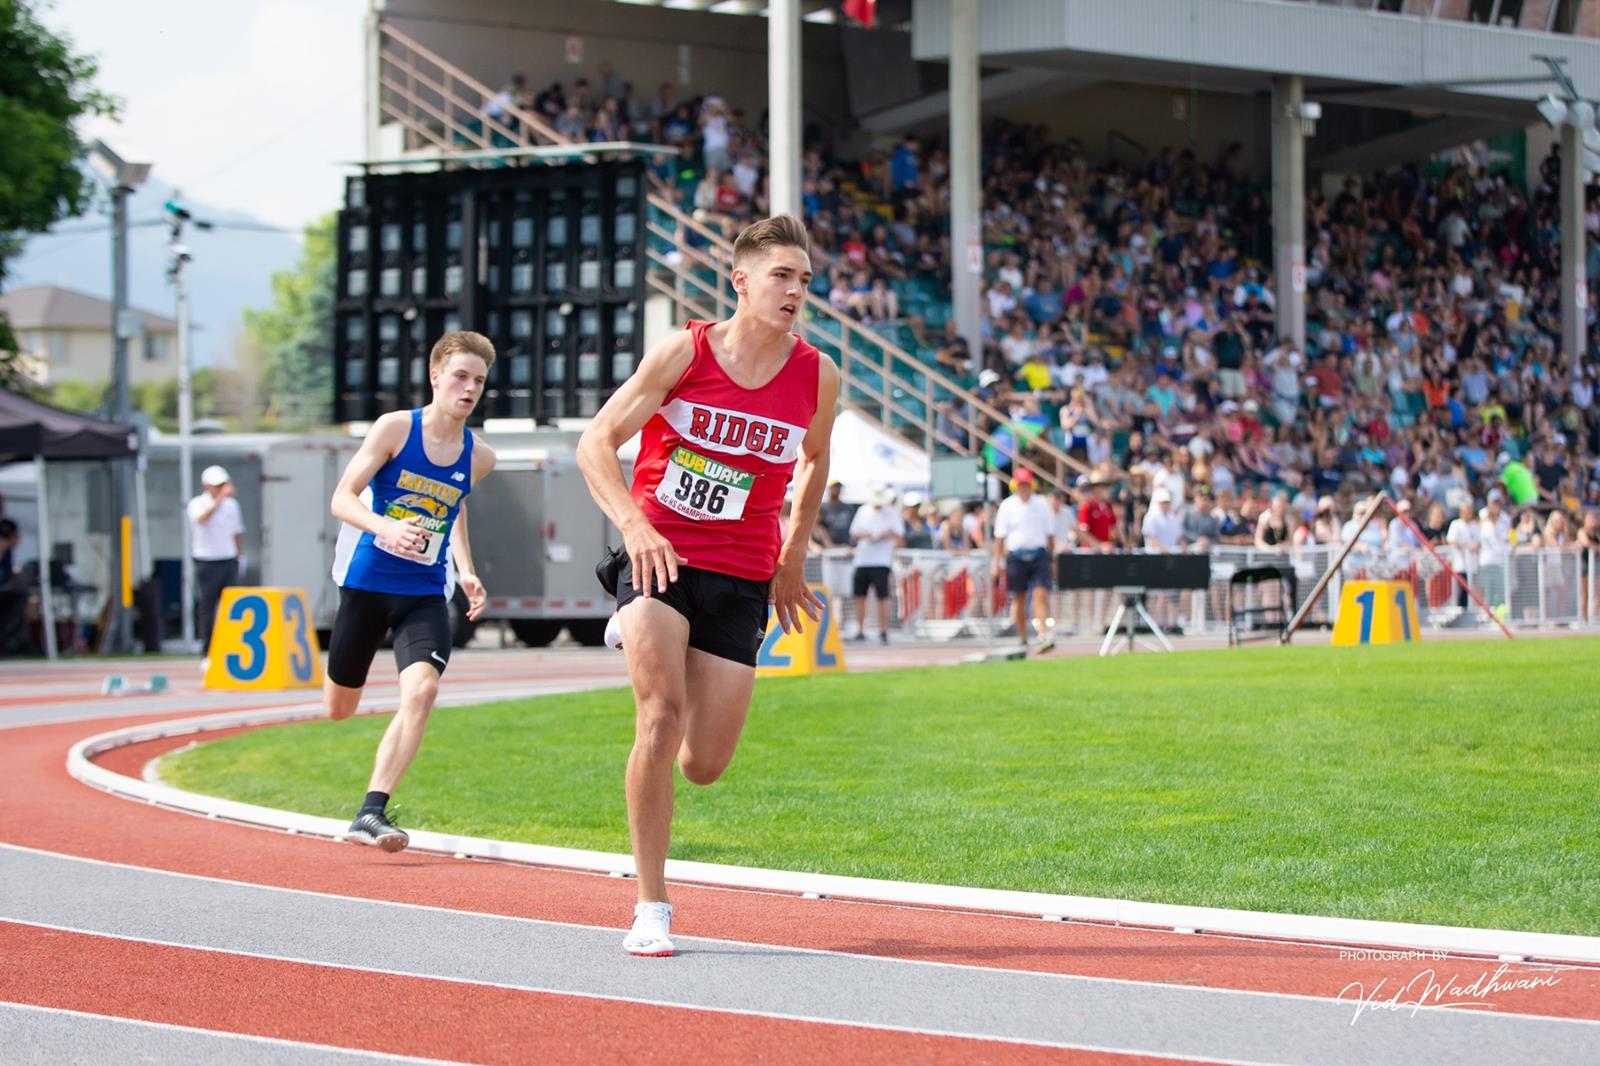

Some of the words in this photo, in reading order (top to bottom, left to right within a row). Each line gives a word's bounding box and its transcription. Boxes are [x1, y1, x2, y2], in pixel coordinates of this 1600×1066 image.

[689, 407, 789, 456] RIDGE
[674, 449, 749, 485] SUBWAY
[674, 471, 729, 514] 986
[226, 595, 269, 681] 3
[284, 594, 313, 682] 3
[809, 589, 836, 667] 2
[1356, 590, 1375, 644] 1
[1395, 590, 1411, 642] 1
